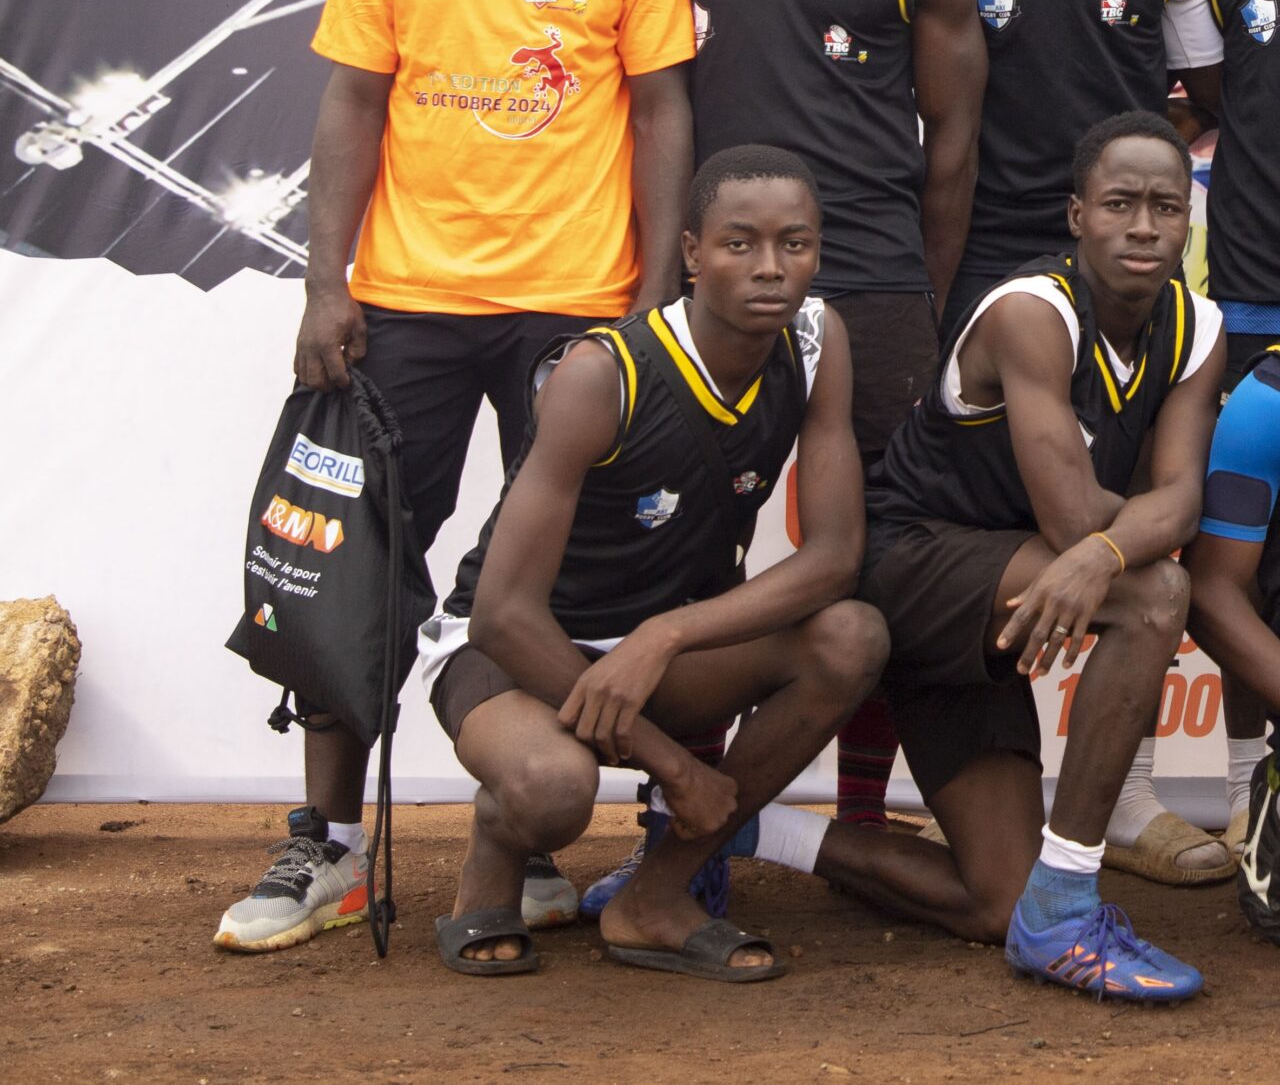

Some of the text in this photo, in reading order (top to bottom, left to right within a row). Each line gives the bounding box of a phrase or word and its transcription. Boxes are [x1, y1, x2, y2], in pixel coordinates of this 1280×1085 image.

[432, 93, 502, 112] OCTOBRE
[507, 98, 551, 113] 2024
[280, 562, 292, 574] le
[292, 567, 321, 582] sport
[277, 578, 319, 598] l'avenir
